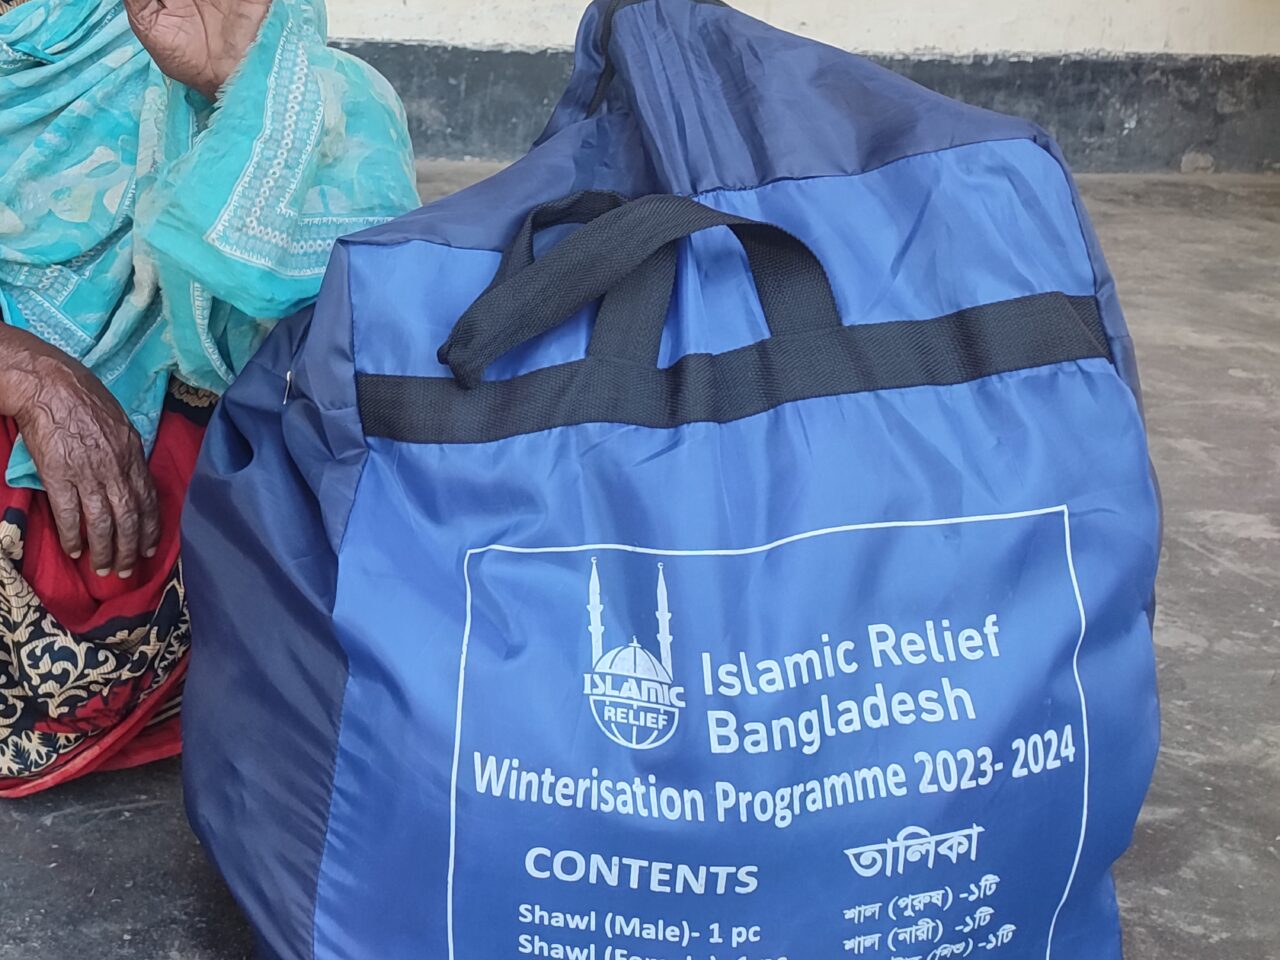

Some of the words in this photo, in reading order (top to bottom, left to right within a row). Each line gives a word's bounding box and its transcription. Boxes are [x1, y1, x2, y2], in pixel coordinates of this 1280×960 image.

[701, 634, 859, 697] Islamic
[868, 614, 1001, 667] Relief
[583, 673, 686, 708] ISLAMIC
[604, 706, 668, 730] RELIEF
[707, 678, 976, 755] Bangladesh
[473, 751, 705, 822] Winterisation
[715, 763, 908, 828] Programme
[1011, 724, 1076, 778] 2024
[524, 847, 759, 894] CONTENTS
[843, 822, 985, 878] তালিকা
[518, 903, 596, 932] Shawl
[708, 923, 723, 944] 1
[731, 925, 762, 947] pc
[843, 902, 883, 924] শাল
[887, 886, 954, 921] (পুরুষ)
[518, 933, 596, 960] Shawl
[843, 933, 883, 955] শাল
[887, 917, 944, 952] (নারী)
